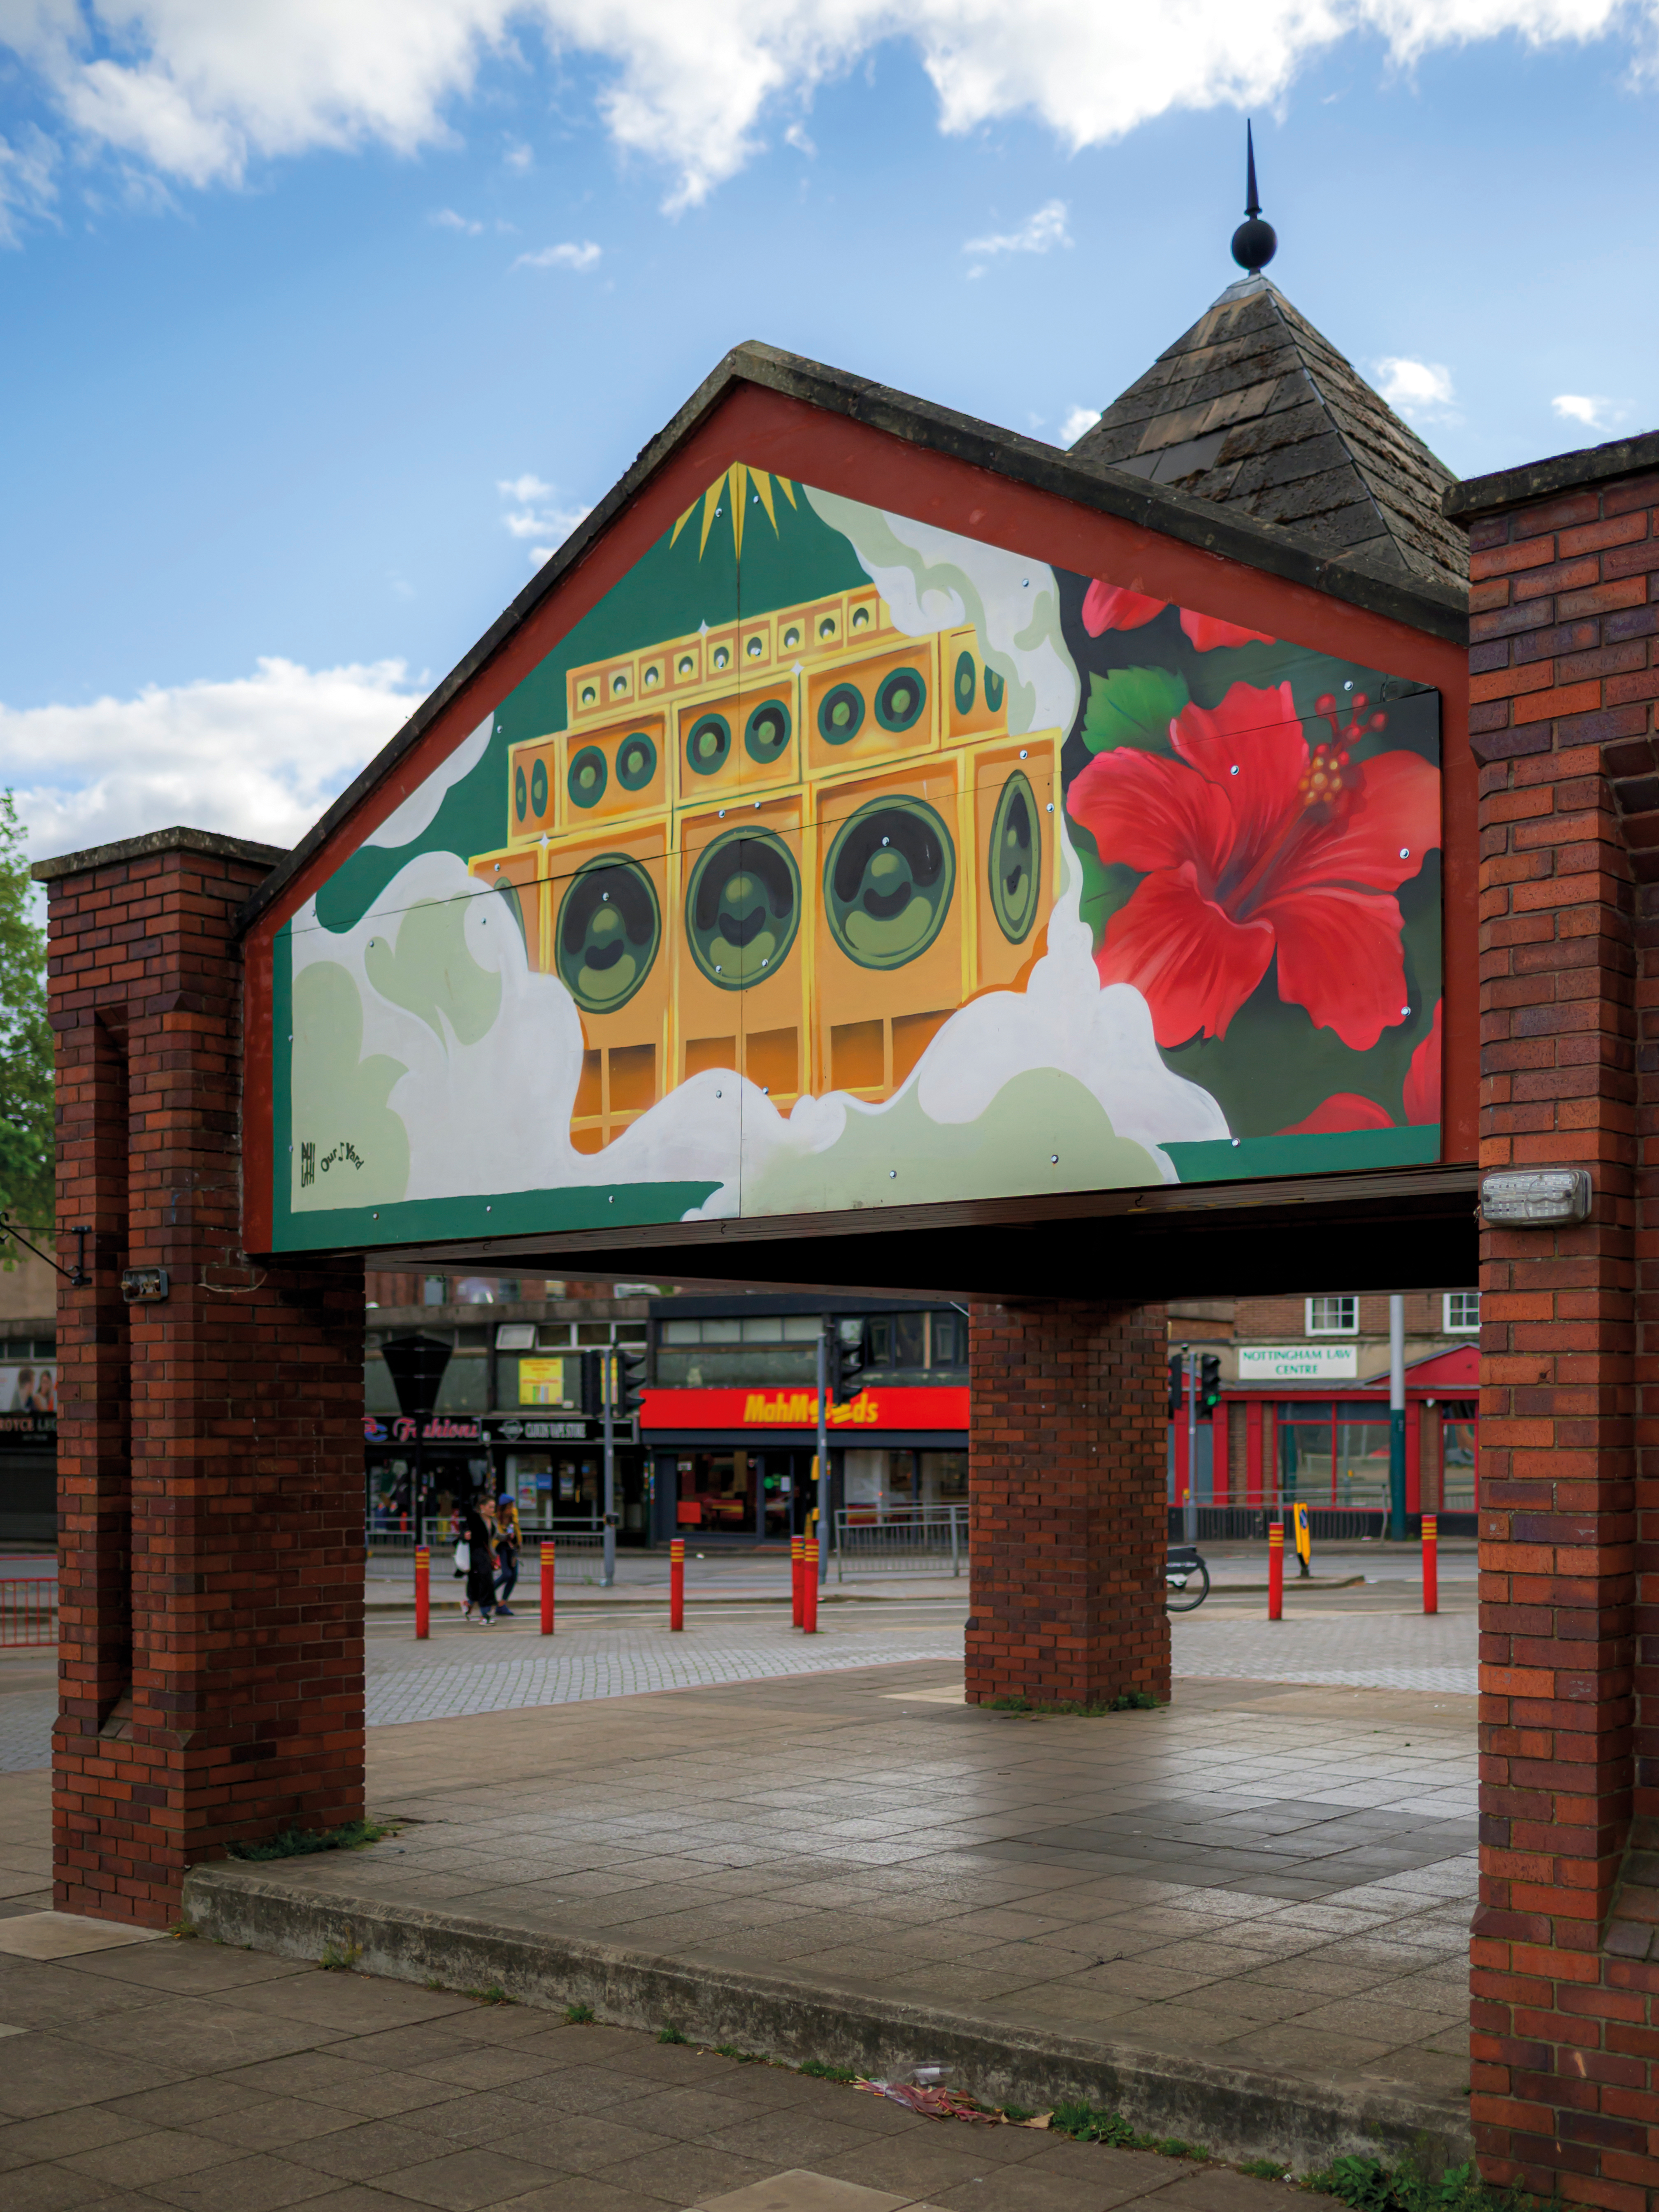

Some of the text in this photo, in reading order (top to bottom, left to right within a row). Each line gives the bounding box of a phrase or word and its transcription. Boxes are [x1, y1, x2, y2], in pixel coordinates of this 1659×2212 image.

[321, 1142, 364, 1172] Our Yard
[1243, 1349, 1352, 1361] NOTTINGHAM LAW
[1276, 1365, 1318, 1375] CENTRE
